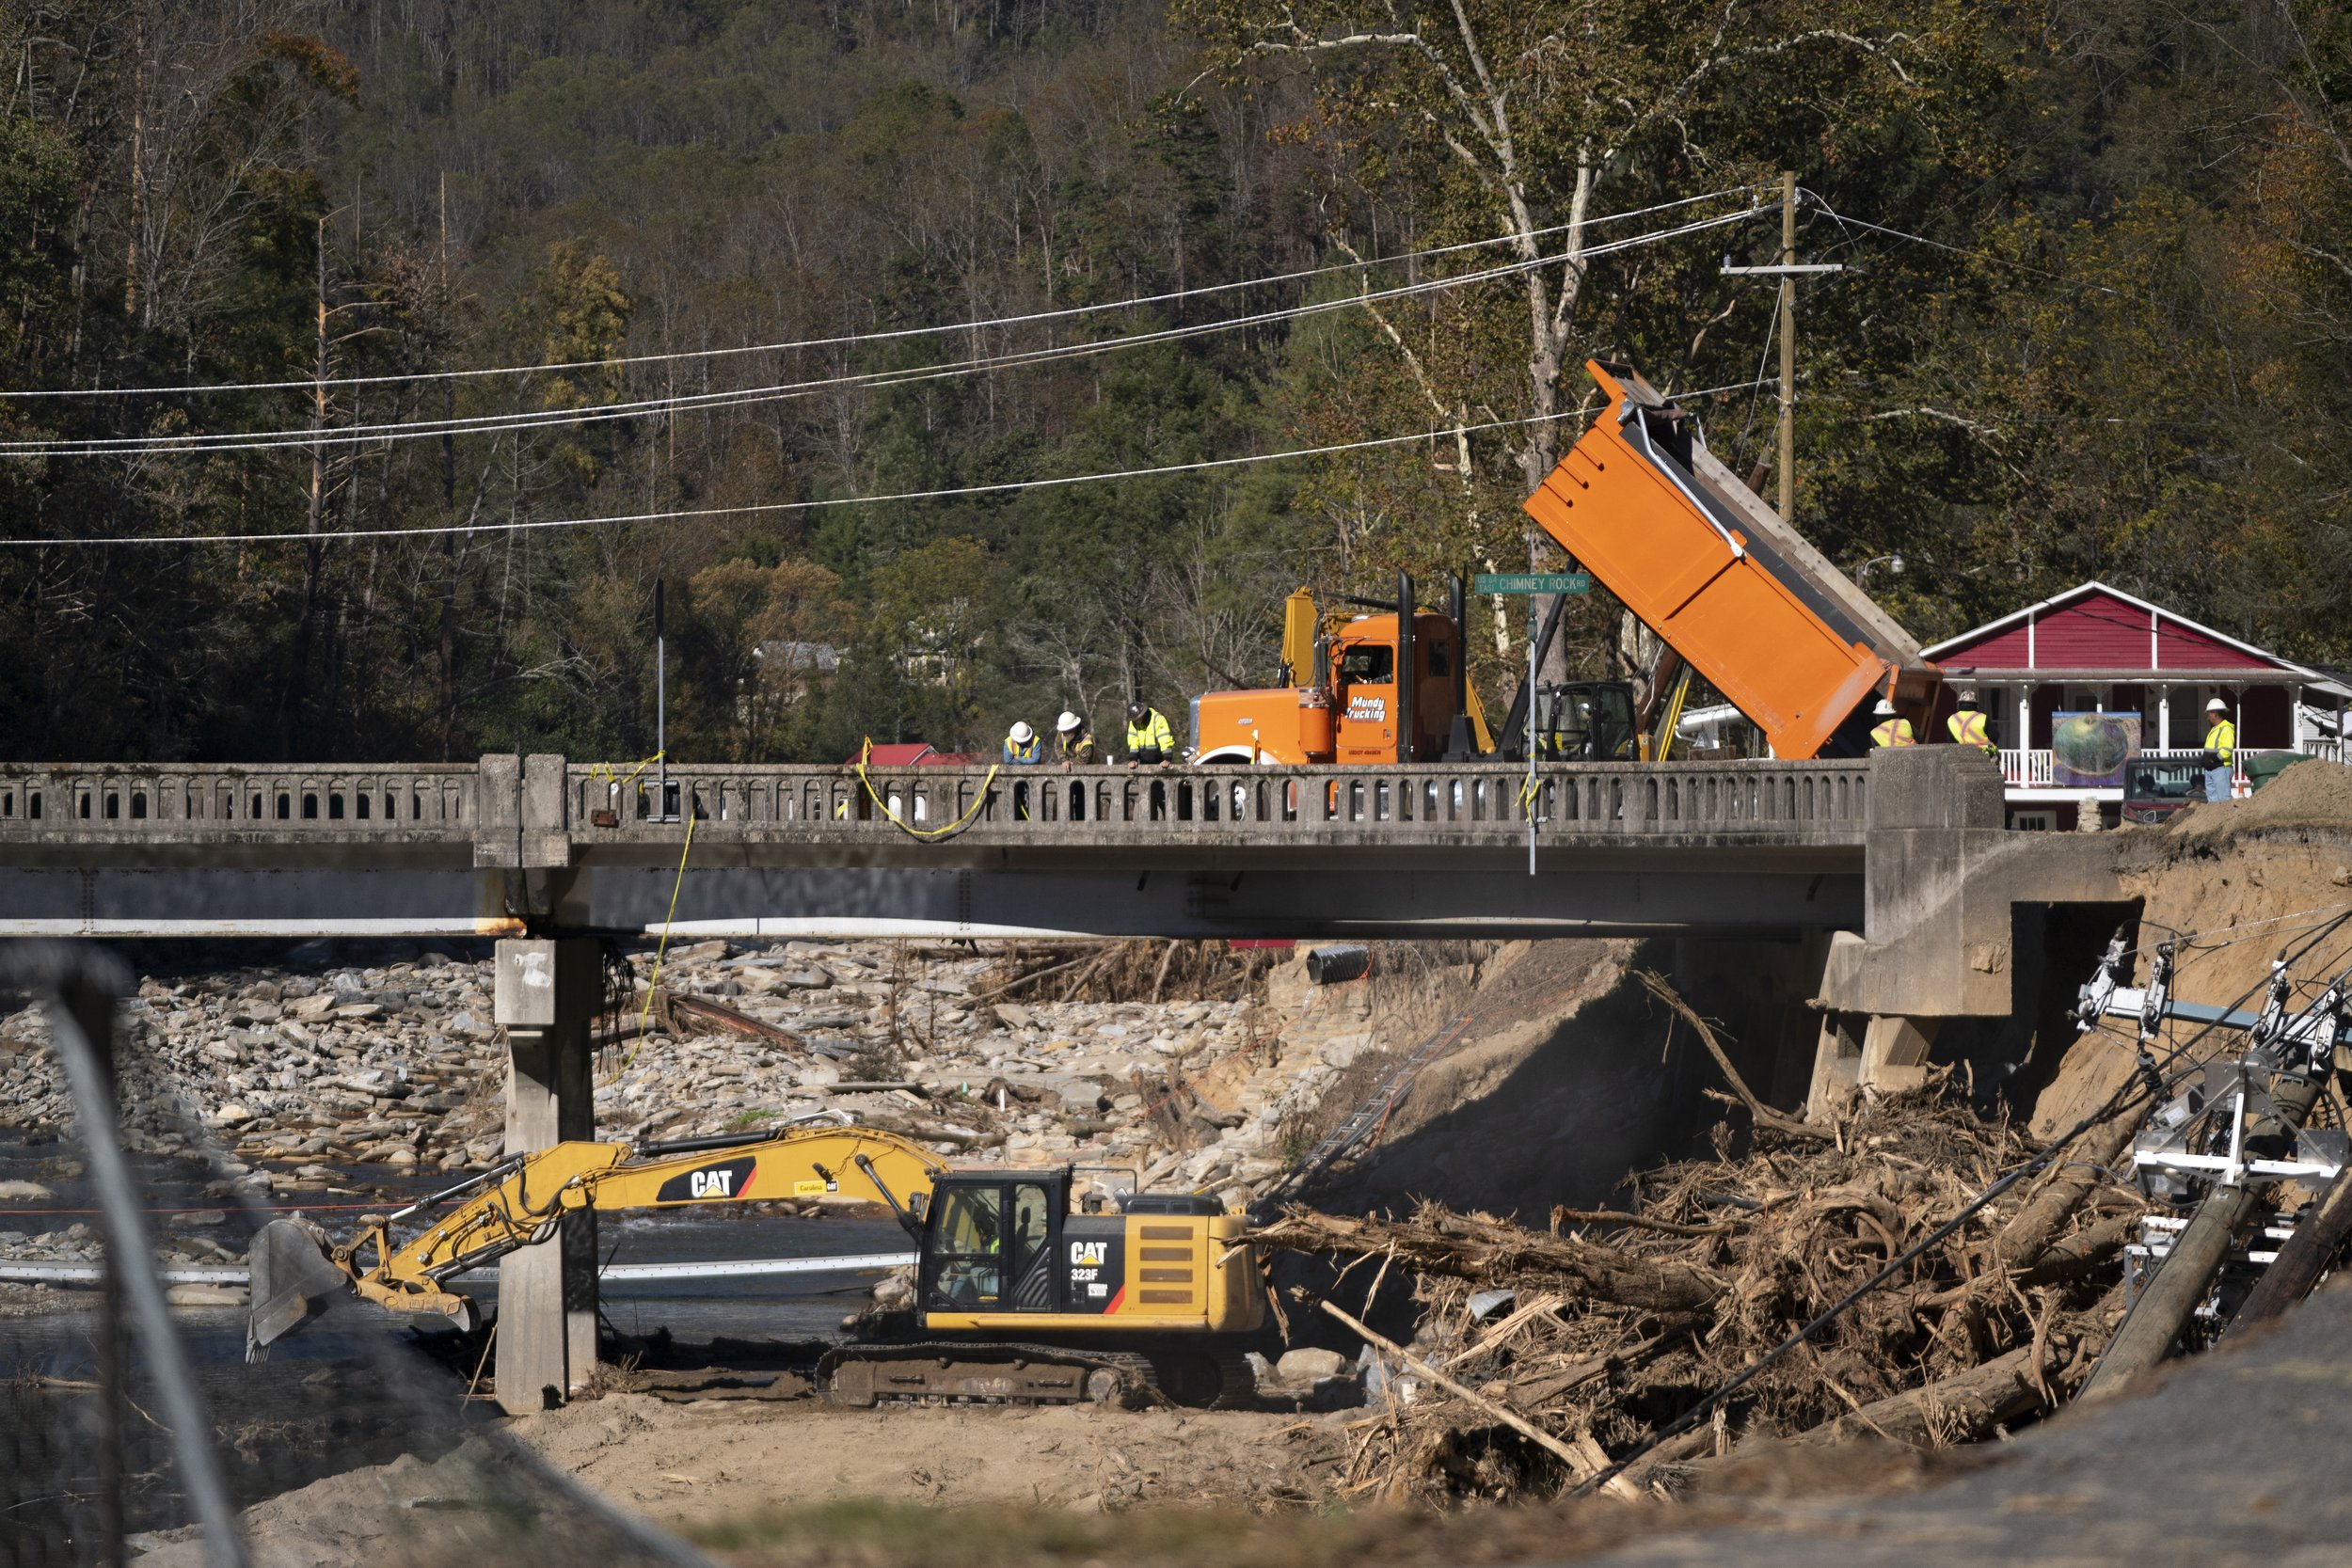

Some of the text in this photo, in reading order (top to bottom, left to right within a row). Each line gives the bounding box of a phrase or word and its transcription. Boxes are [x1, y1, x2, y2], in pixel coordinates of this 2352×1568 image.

[1477, 576, 1497, 584] US 64
[1500, 578, 1545, 590] CHIMNEY
[1549, 578, 1577, 590] ROCK
[1352, 696, 1385, 711] Mundy
[691, 1170, 732, 1197] CAT
[1071, 1242, 1107, 1265] CAT
[1071, 1268, 1098, 1280] 323F
